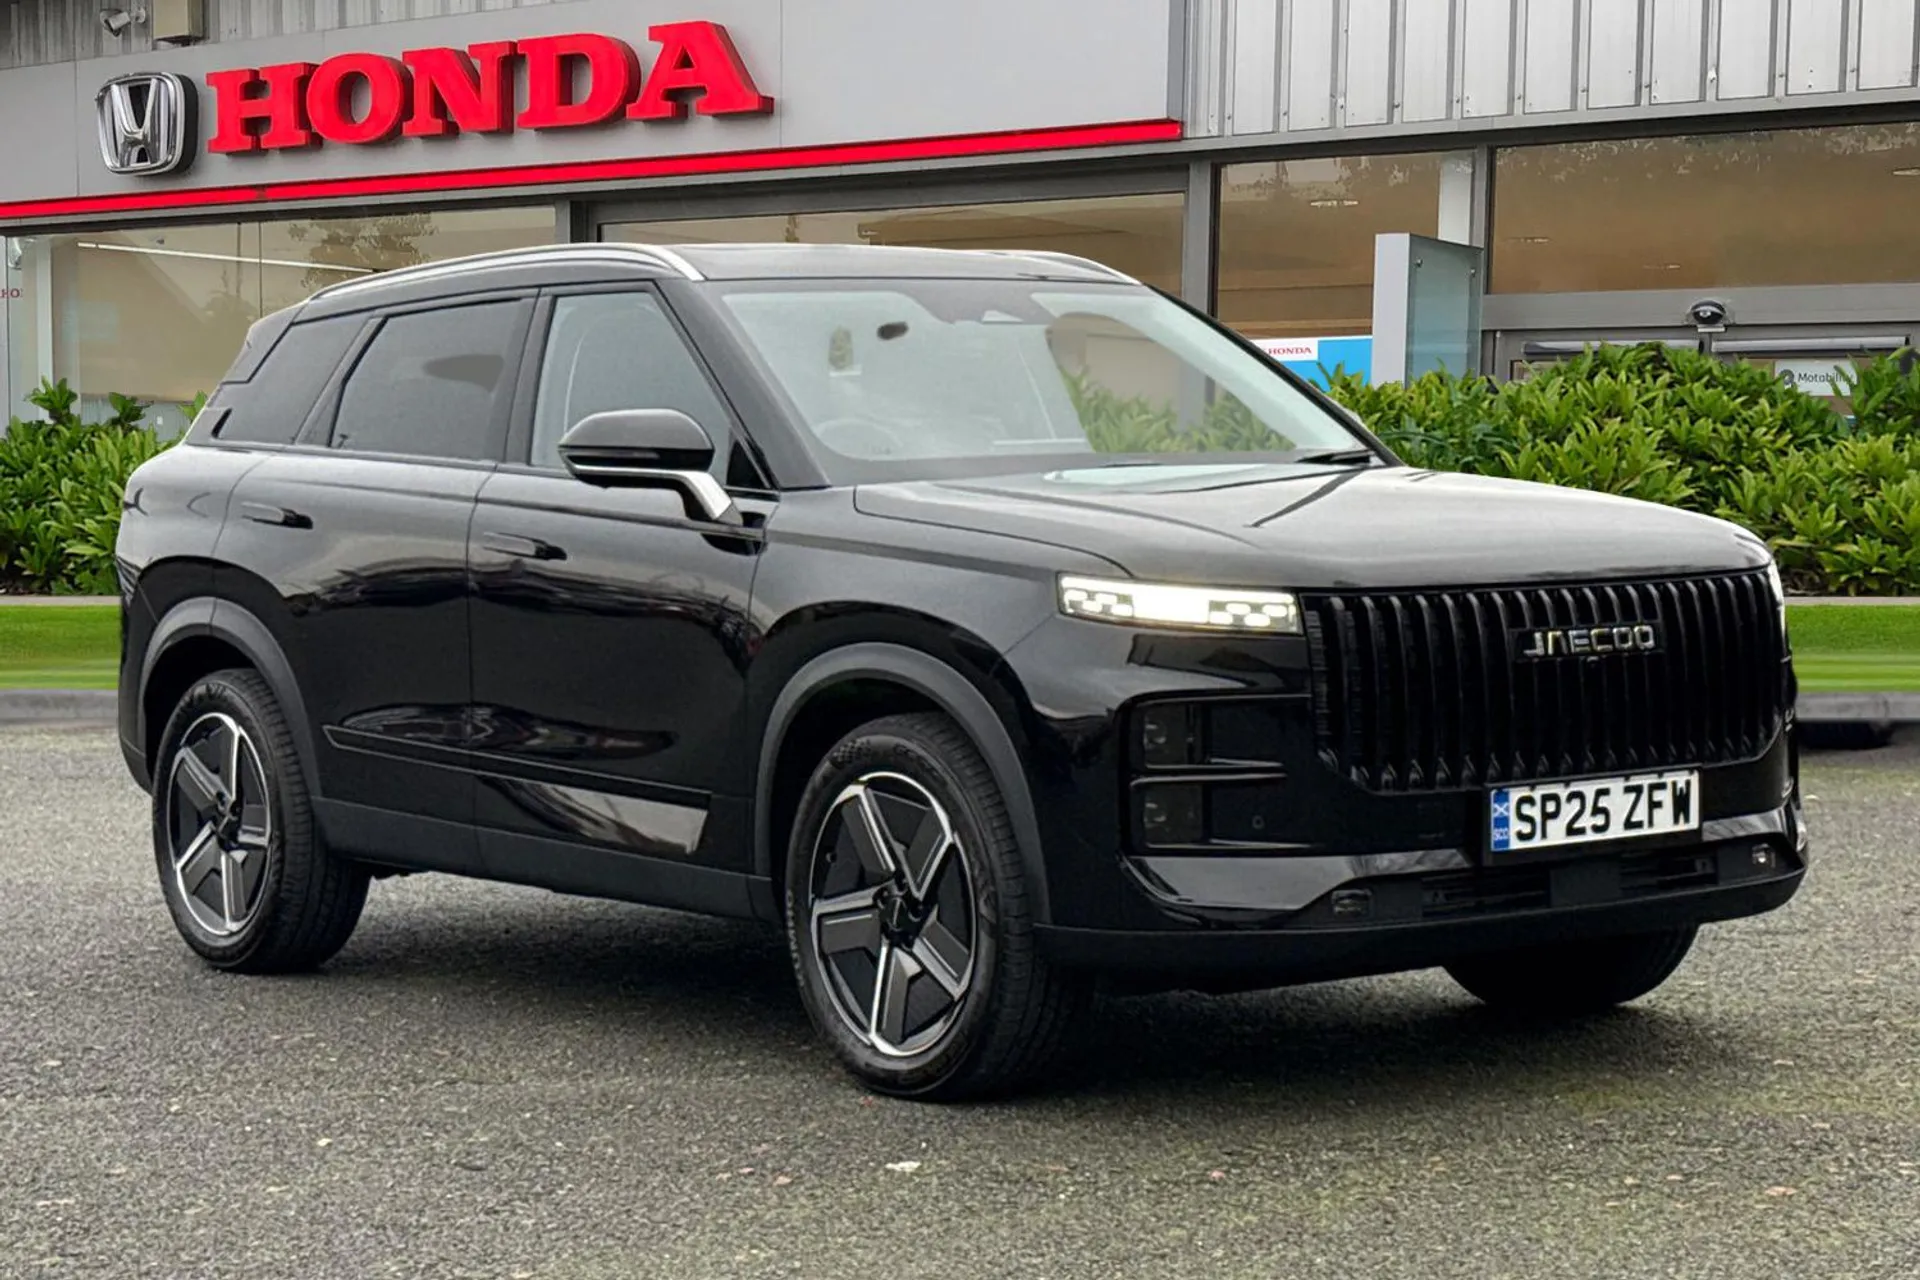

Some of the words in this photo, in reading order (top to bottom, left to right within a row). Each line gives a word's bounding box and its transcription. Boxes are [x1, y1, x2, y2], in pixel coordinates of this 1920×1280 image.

[206, 20, 774, 154] HONDA
[1268, 346, 1312, 355] HONDA
[1523, 625, 1655, 657] JAECOO
[1515, 790, 1611, 841] SP25
[1623, 779, 1692, 831] ZFW
